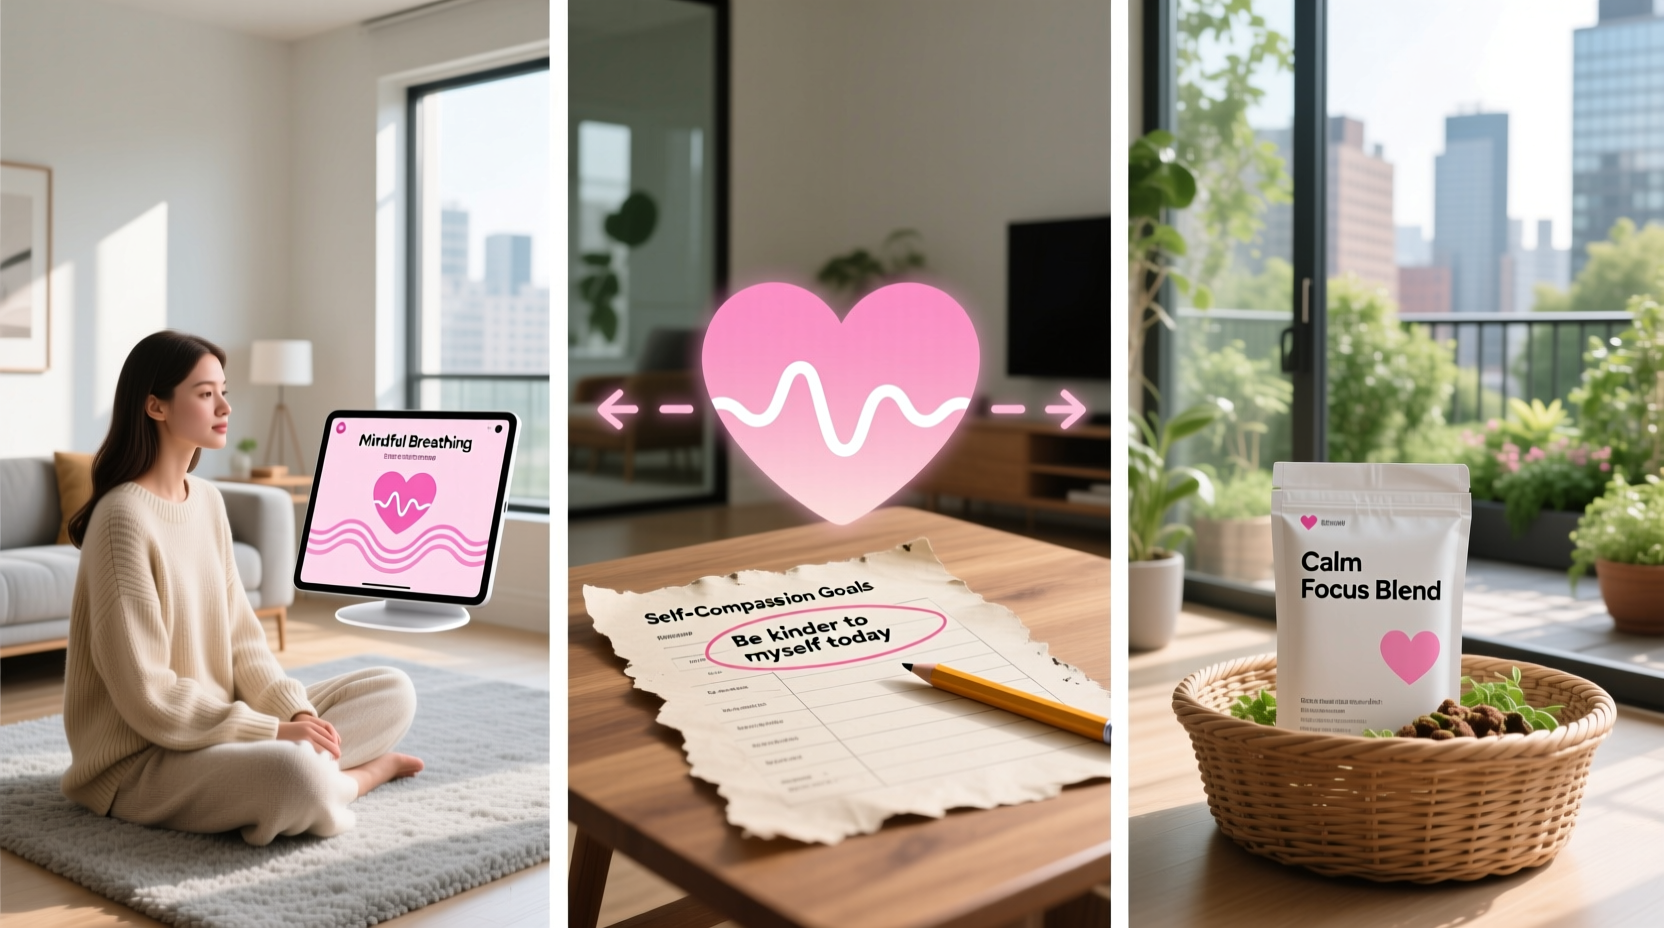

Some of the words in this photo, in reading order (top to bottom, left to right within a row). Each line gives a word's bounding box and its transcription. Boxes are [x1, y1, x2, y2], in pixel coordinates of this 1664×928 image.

[358, 433, 407, 448] Mindful
[408, 434, 473, 453] Breathing
[1301, 550, 1362, 573] Calm
[644, 592, 816, 625] Self-Compassion
[818, 580, 874, 598] Goals
[1301, 578, 1370, 600] Focus
[1375, 578, 1442, 601] Blend
[731, 634, 763, 648] Be
[767, 620, 839, 642] kinder
[843, 615, 868, 629] to
[744, 637, 822, 663] myself
[827, 628, 891, 648] today
